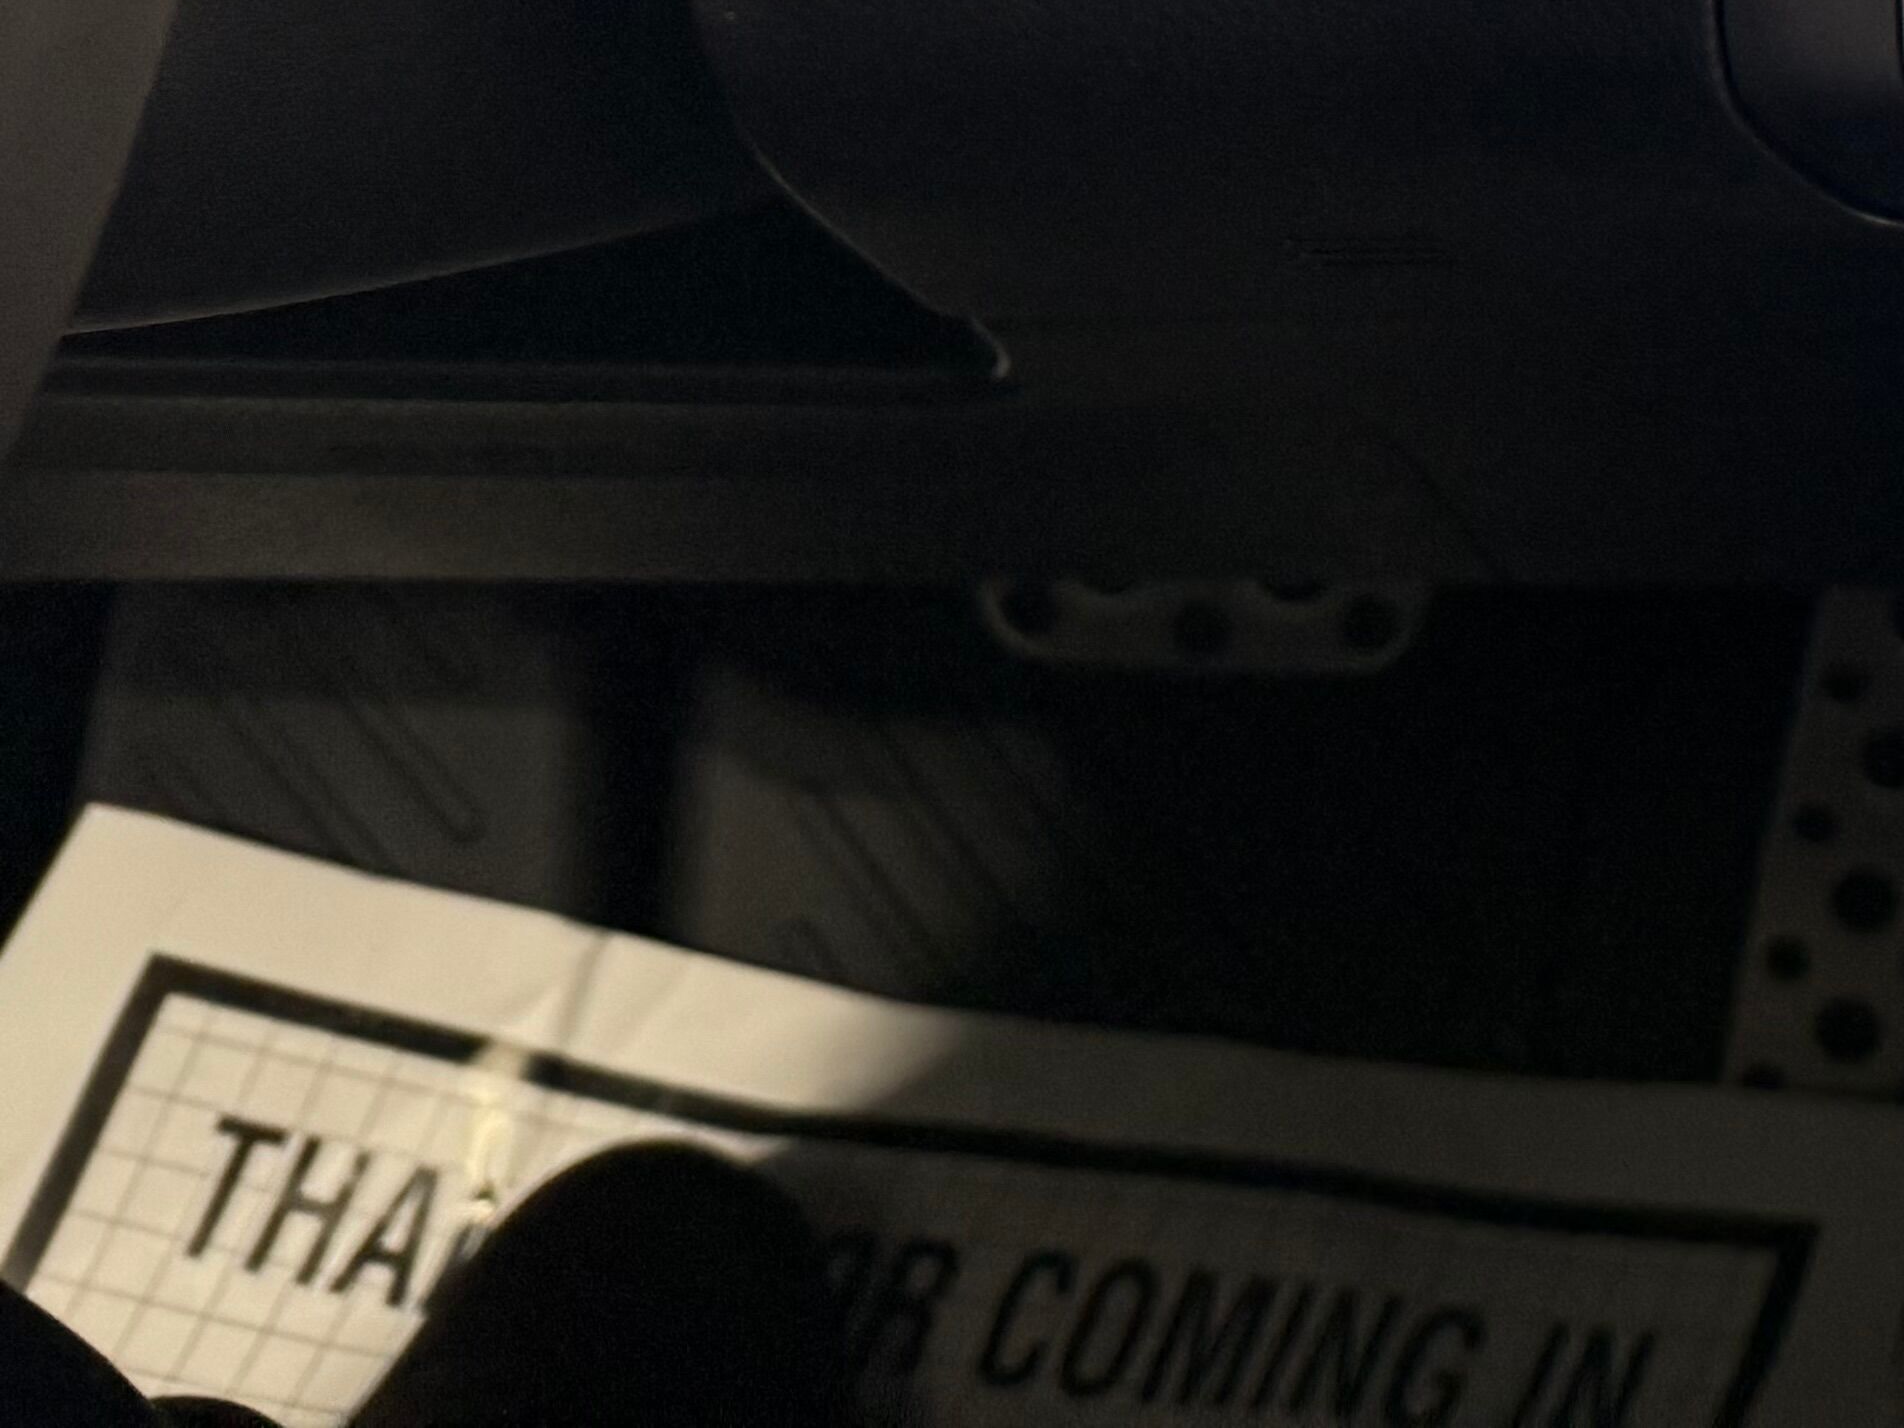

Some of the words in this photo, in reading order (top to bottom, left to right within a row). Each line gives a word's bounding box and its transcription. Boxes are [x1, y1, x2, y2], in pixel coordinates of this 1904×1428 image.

[187, 1115, 478, 1309] THA
[978, 1244, 1486, 1428] COMING
[1511, 1319, 1657, 1428] IN
